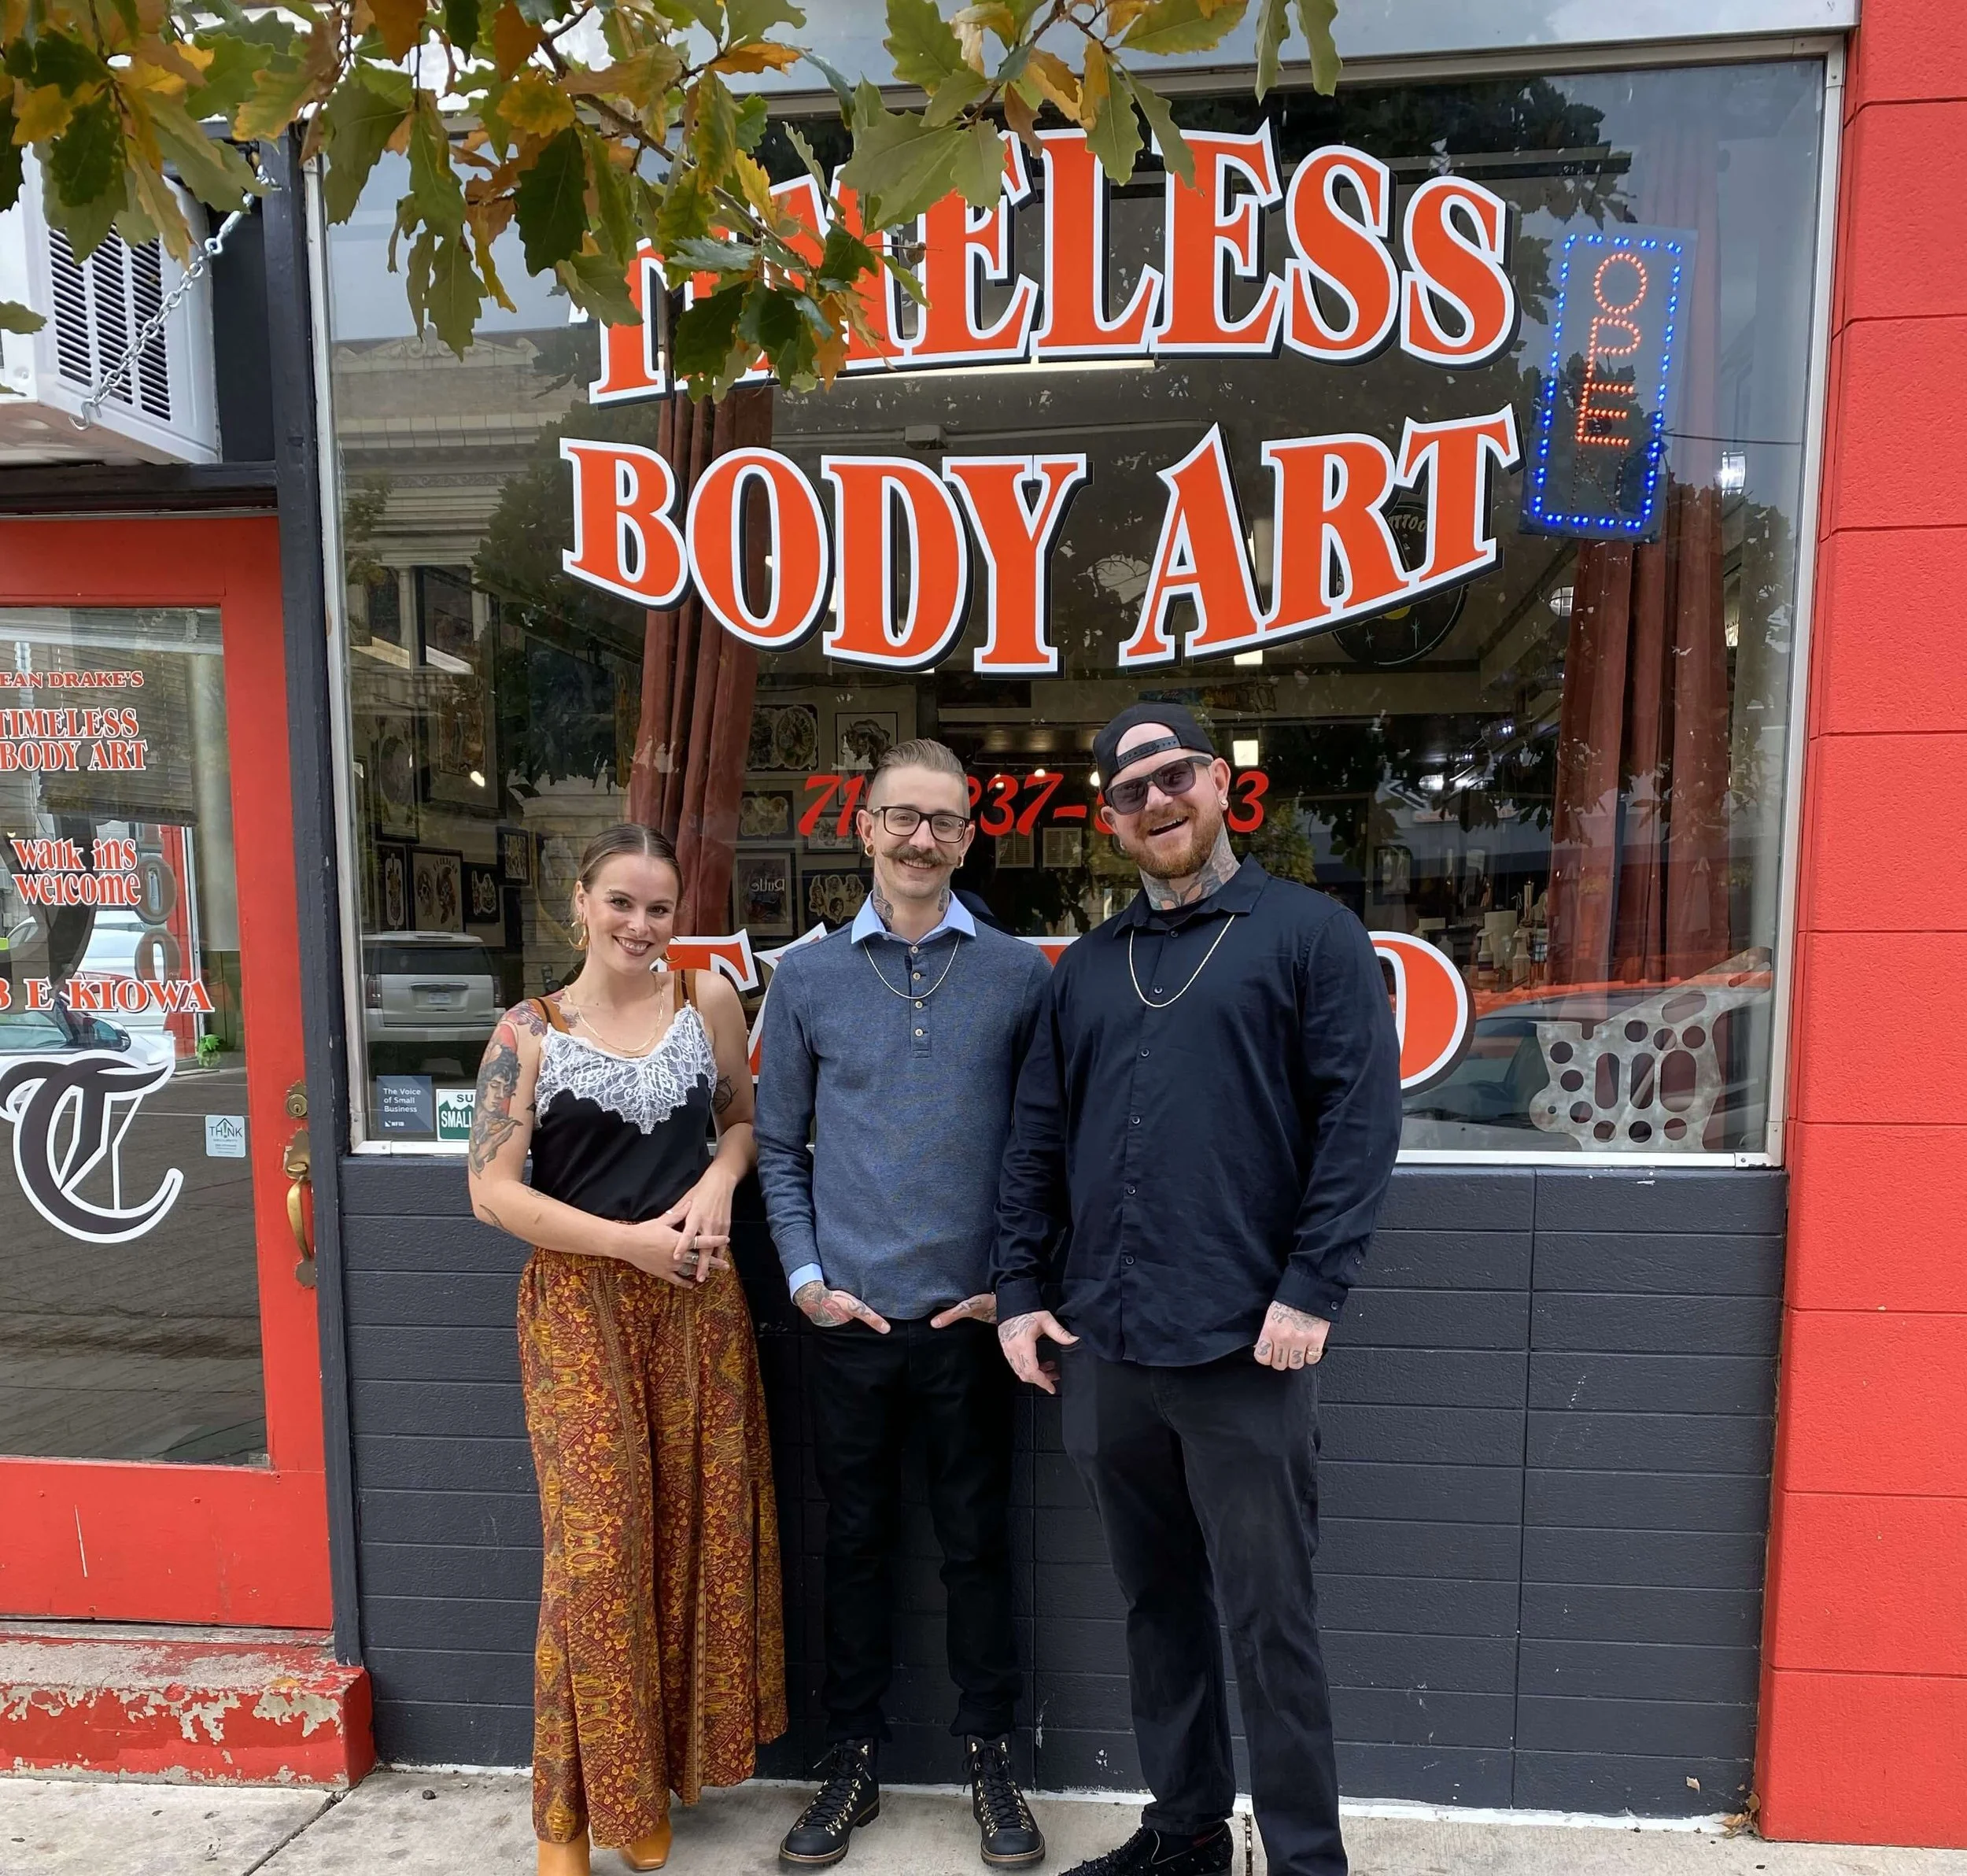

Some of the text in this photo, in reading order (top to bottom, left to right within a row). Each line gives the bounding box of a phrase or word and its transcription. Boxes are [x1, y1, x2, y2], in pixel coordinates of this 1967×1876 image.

[570, 118, 1518, 403] MELESS
[559, 404, 1522, 678] BODY ART
[0, 670, 145, 689] EAN DRAKE'S
[0, 707, 139, 739] TIMELESS
[0, 739, 148, 771] BODY ART
[90, 837, 138, 871] ins
[23, 977, 55, 1012] E
[65, 977, 216, 1013] KIOWA
